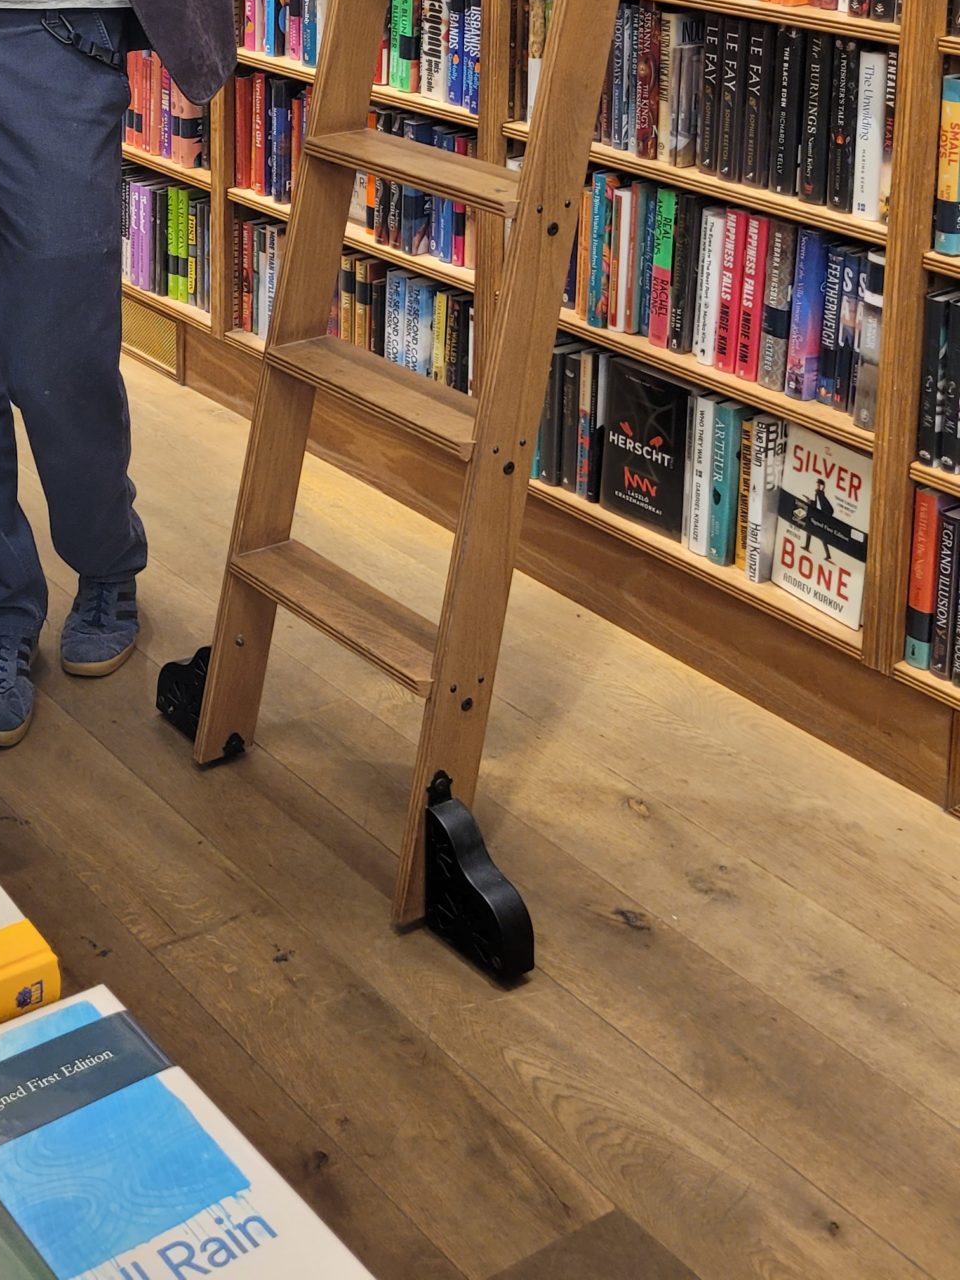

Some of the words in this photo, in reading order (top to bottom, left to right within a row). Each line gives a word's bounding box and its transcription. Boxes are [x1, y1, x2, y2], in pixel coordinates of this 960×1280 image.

[706, 26, 718, 45] LE
[726, 33, 739, 52] LE
[750, 36, 763, 56] LE
[812, 38, 822, 59] The
[704, 53, 717, 84] FAY
[724, 60, 737, 91] FAY
[748, 64, 762, 96] FAY
[864, 64, 875, 89] The
[885, 51, 898, 108] KENEALLY
[807, 64, 820, 134] BURNINGS
[859, 89, 875, 141] Unwilding
[778, 111, 786, 145] RICHARD
[837, 105, 845, 126] TALE
[939, 128, 948, 158] JOYS
[948, 122, 960, 166] SMALL
[654, 199, 663, 255] AMERICANS
[661, 216, 671, 240] REAL
[722, 213, 737, 270] HAPPINESS
[745, 219, 759, 276] HAPPINESS
[650, 276, 661, 314] KHONG
[658, 275, 669, 317] RACHEL
[721, 270, 733, 301] FALLS
[742, 277, 755, 308] FALLS
[719, 303, 730, 335] ANGIE
[740, 310, 752, 341] ANGIE
[716, 335, 728, 356] KIM
[738, 342, 749, 364] KIM
[609, 431, 671, 467] HERSCHT
[757, 421, 766, 445] Blue
[713, 418, 726, 482] ARTHUR
[753, 445, 766, 467] Ruin
[793, 444, 862, 502] SILVER
[615, 490, 662, 516] KRASZNAHORKAI
[751, 522, 762, 544] Hari
[747, 545, 761, 583] Kunzru
[781, 535, 852, 602] BONE
[941, 528, 954, 577] GRAND
[812, 588, 844, 614] KURKOV
[938, 578, 952, 629] ILLUSION
[27, 1066, 62, 1094] First
[61, 1048, 115, 1080] Edition
[157, 1206, 279, 1280] Rain
